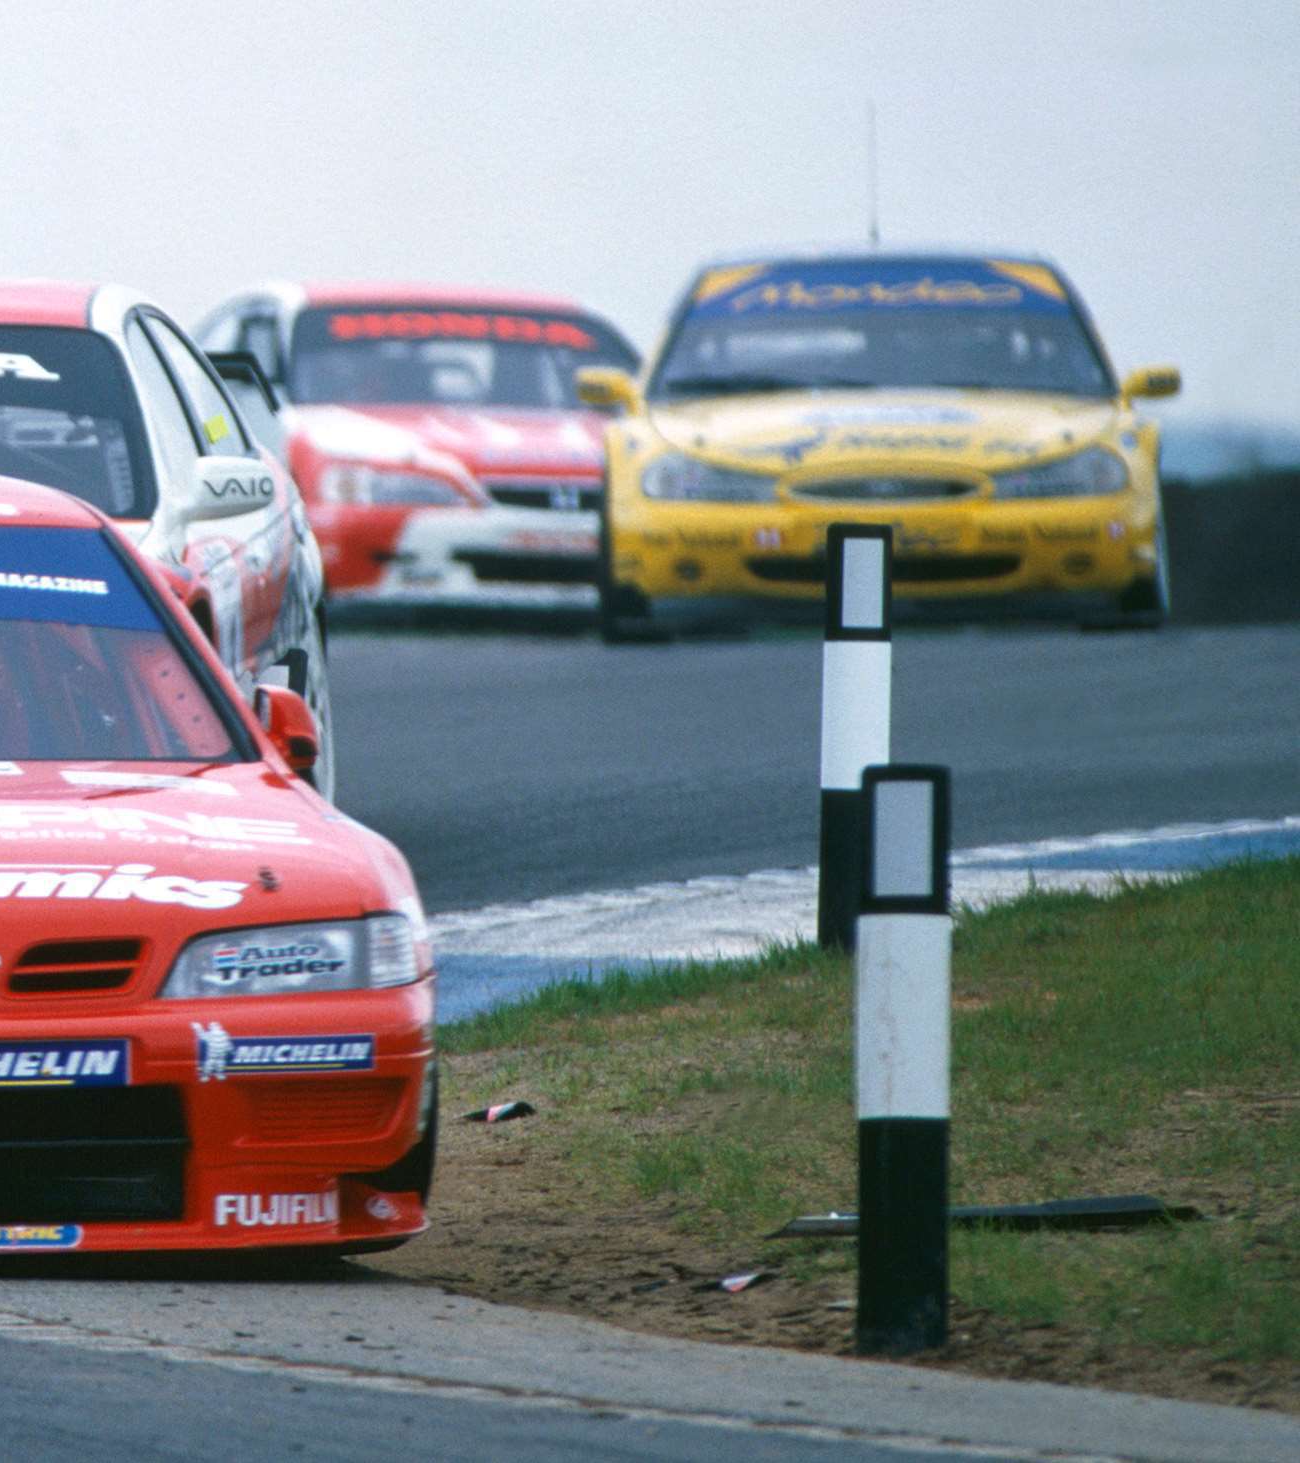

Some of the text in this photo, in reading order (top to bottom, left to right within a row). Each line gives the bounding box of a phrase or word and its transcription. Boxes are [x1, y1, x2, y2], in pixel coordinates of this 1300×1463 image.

[203, 477, 274, 497] VAIO
[241, 945, 320, 960] Auto
[217, 958, 345, 981] Trader
[233, 1042, 373, 1063] MICHELIN
